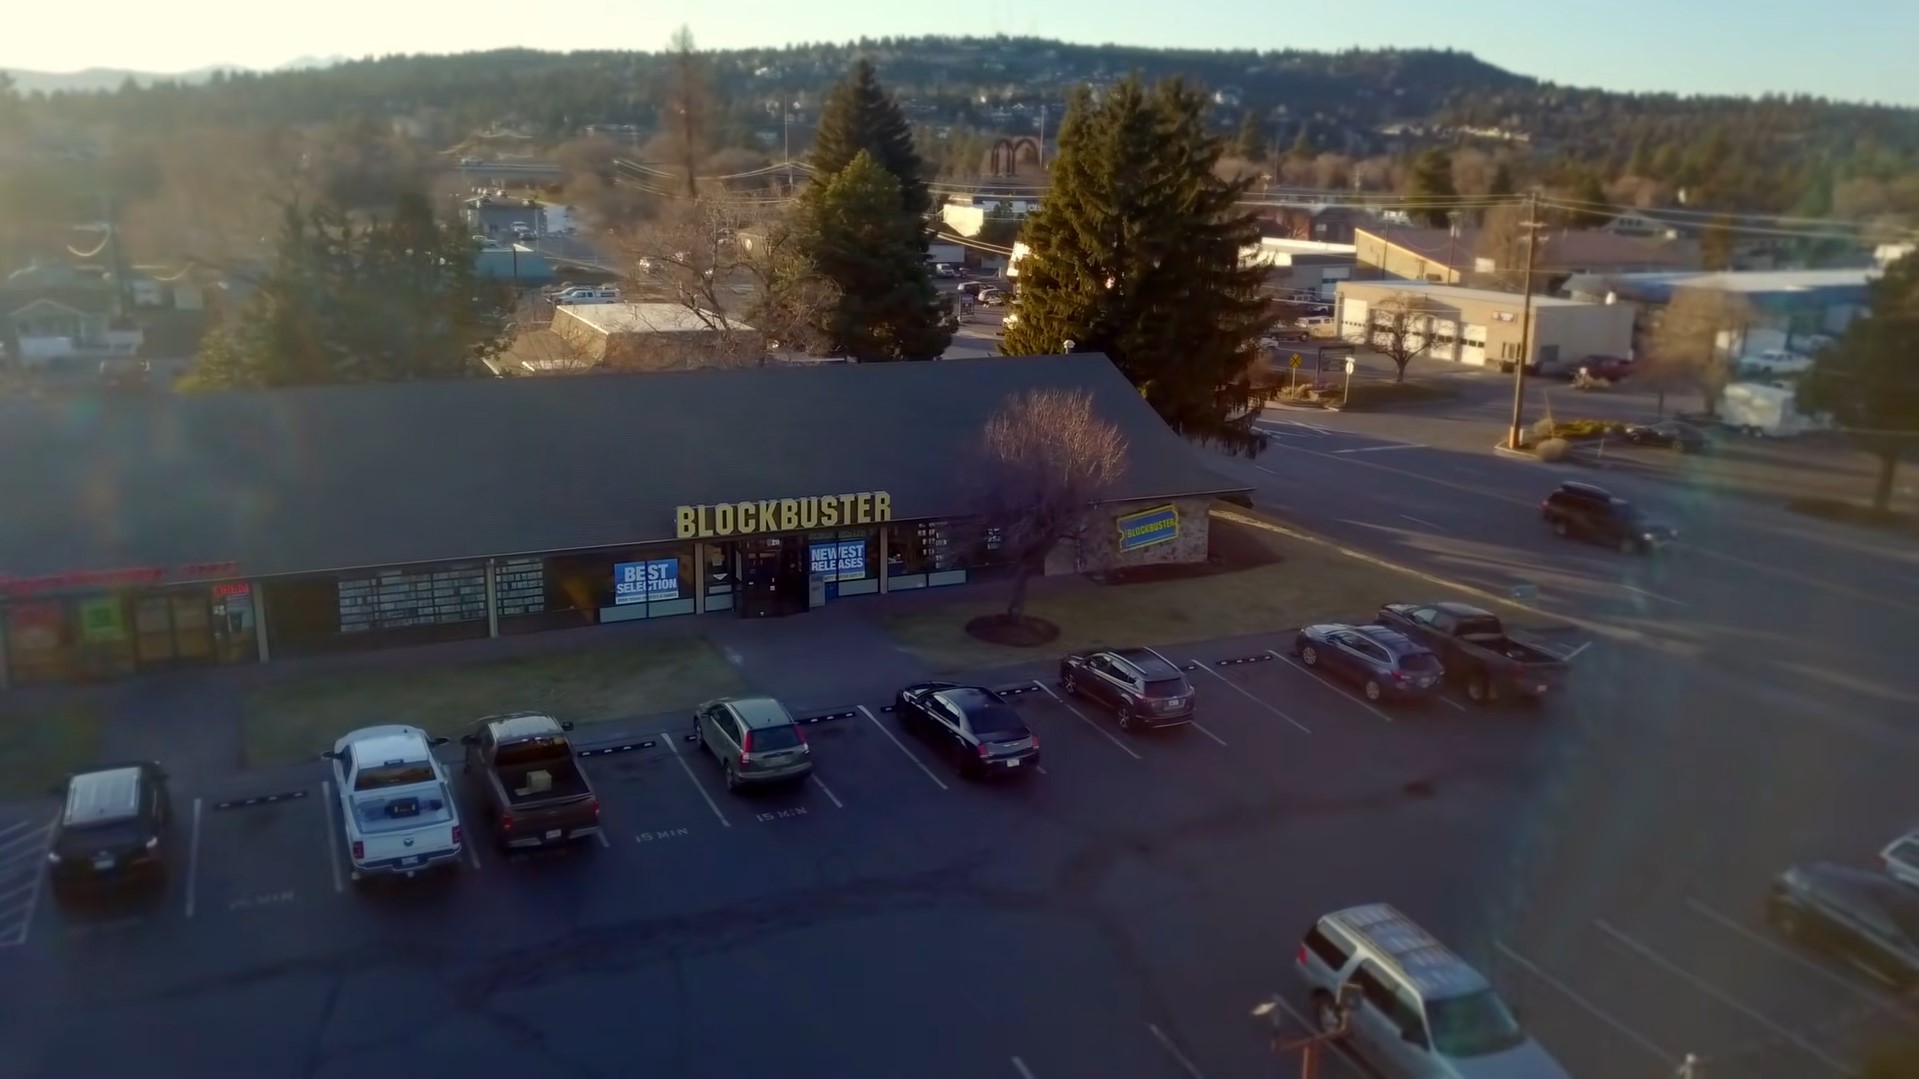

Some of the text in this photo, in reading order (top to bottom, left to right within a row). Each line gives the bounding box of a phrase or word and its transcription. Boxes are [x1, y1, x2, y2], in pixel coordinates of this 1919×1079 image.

[676, 491, 891, 538] BLOCKBUSTER
[1127, 518, 1175, 538] BLOCKBUSTER
[811, 545, 864, 561] NEWEST
[811, 558, 864, 571] RELEASES
[624, 564, 669, 582] BEST
[616, 578, 677, 594] SELECTION
[756, 806, 807, 822] 15 MIN
[636, 828, 689, 843] 15 MIN
